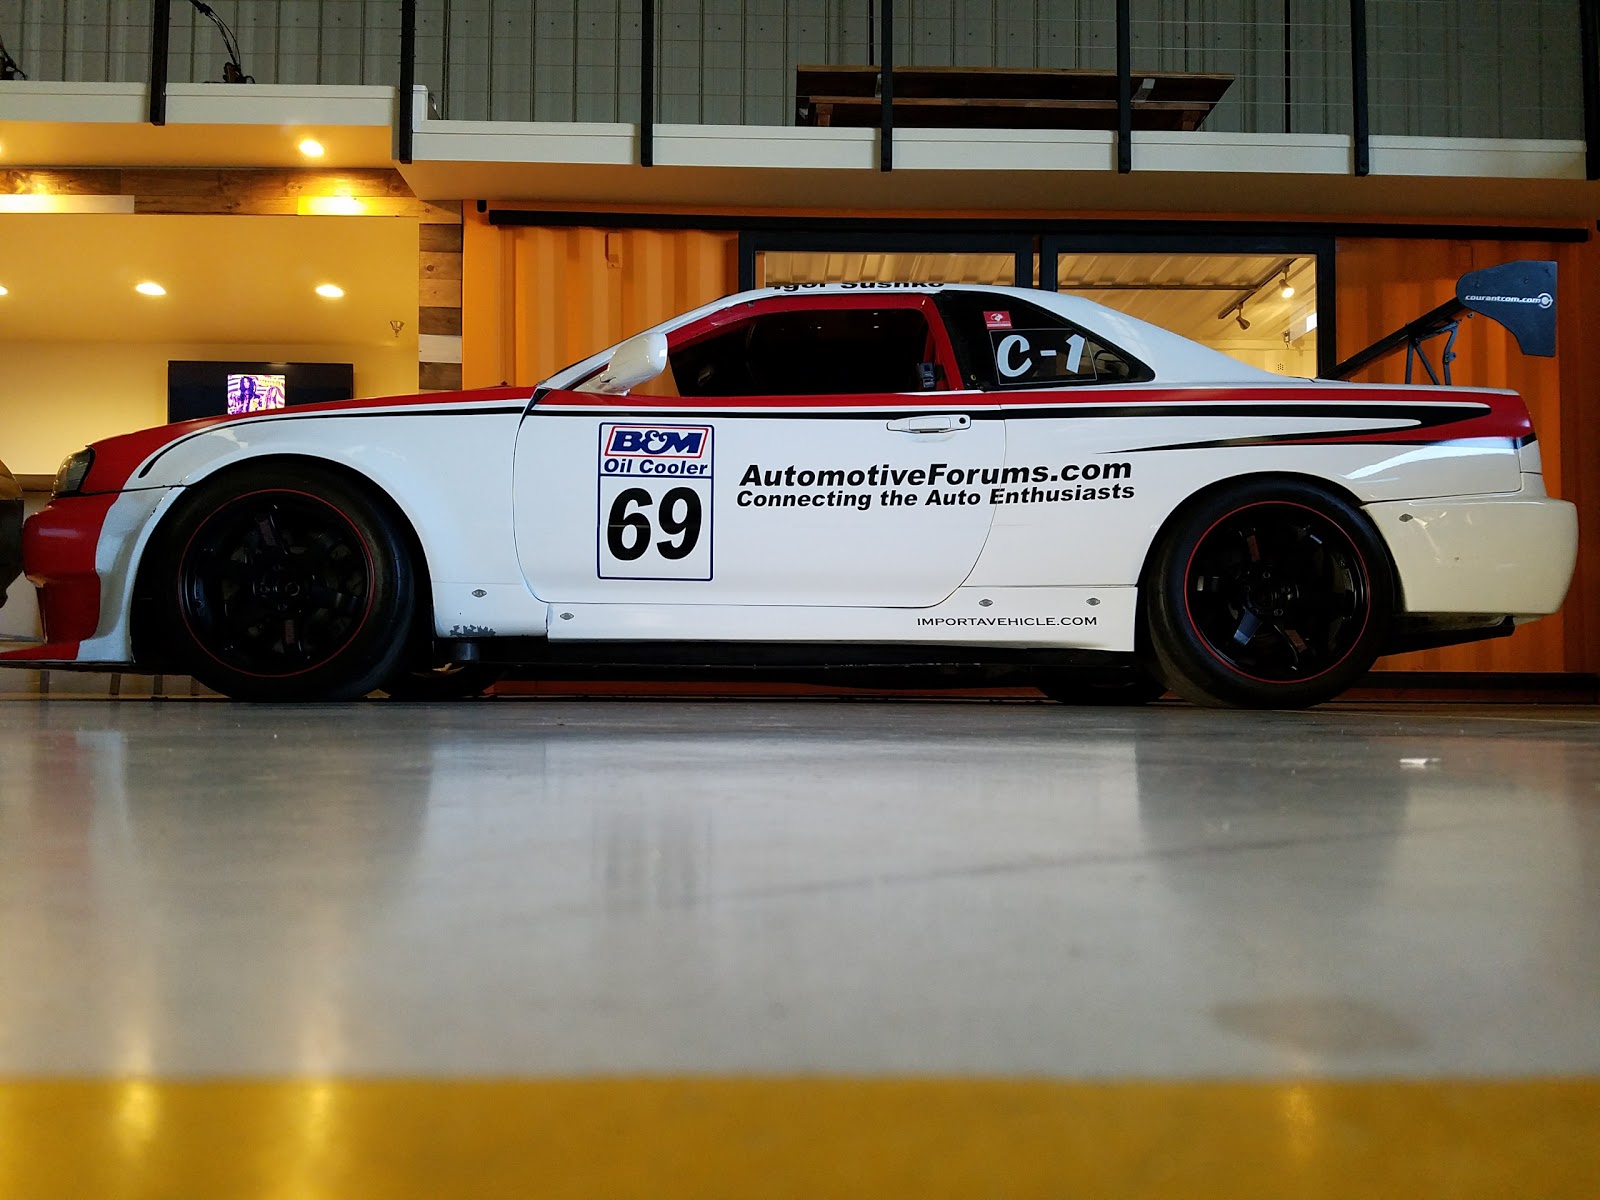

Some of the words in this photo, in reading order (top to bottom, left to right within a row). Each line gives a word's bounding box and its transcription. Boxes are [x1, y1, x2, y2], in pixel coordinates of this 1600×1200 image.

[610, 430, 703, 455] B&M
[604, 458, 633, 473] Oil
[639, 459, 708, 475] Cooler
[739, 462, 1132, 487] AutomotiveForums.com
[737, 490, 872, 511] Connecting
[880, 490, 918, 506] the
[925, 489, 981, 506] Auto
[989, 483, 1135, 504] Enthusiasts
[607, 486, 702, 561] 69
[917, 617, 1098, 626] IMPORTAVEHICLE.COM
